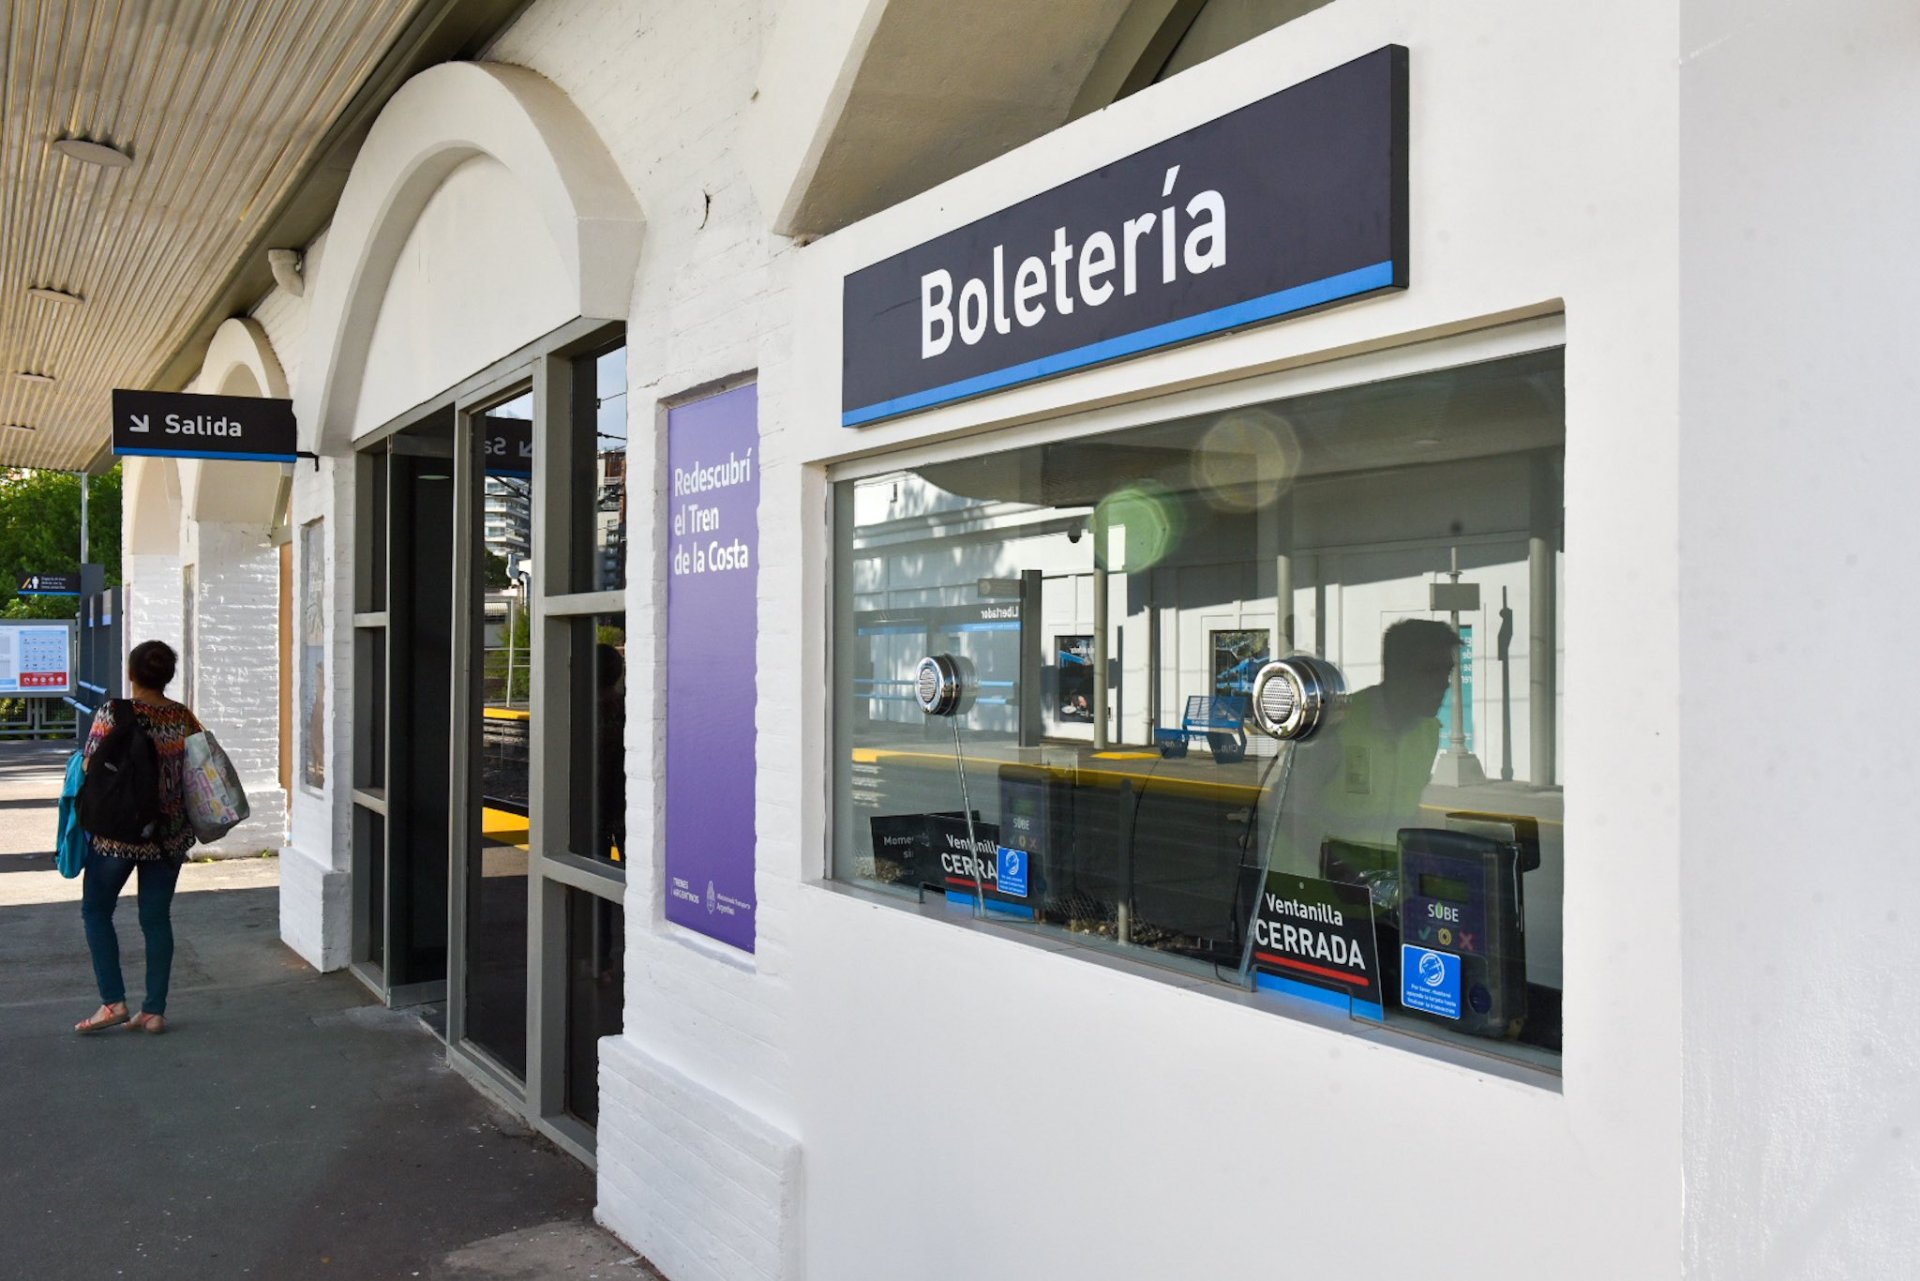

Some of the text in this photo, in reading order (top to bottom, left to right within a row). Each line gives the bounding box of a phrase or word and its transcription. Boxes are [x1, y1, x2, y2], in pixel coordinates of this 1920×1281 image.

[921, 164, 1227, 360] Boletería
[165, 414, 242, 437] Salida
[674, 447, 752, 497] Redescubrí
[674, 503, 720, 536] el Tren
[674, 538, 748, 575] de la Costa
[1265, 892, 1344, 926] Ventanilla
[1427, 902, 1459, 922] SUBE
[1255, 918, 1367, 970] CERRADA
